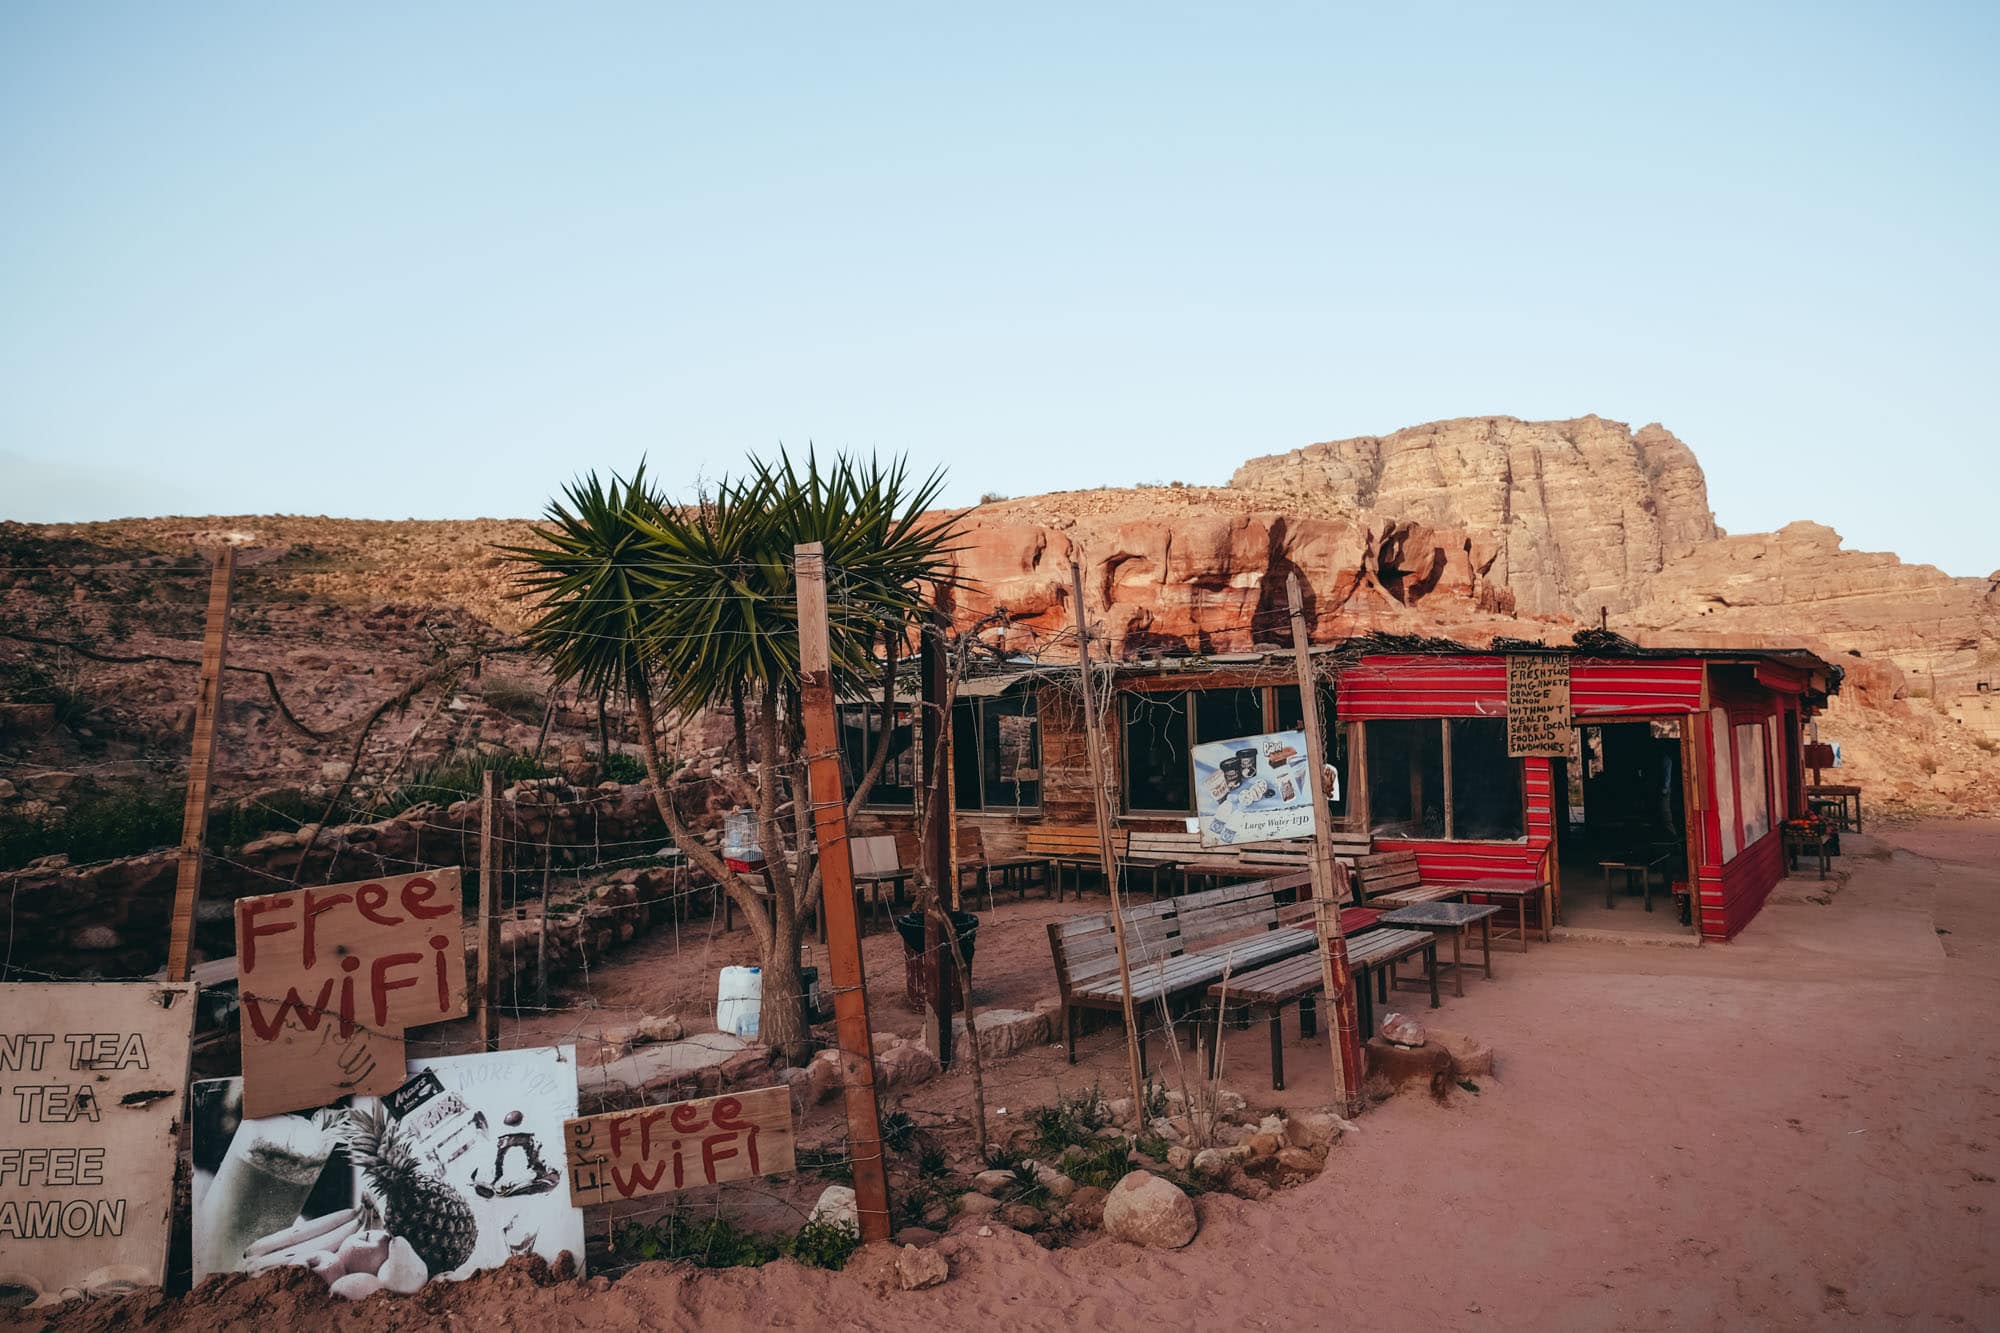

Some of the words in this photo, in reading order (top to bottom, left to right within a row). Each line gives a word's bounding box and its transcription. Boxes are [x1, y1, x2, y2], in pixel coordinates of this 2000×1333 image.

[1512, 656, 1537, 669] 100%
[1510, 690, 1551, 698] ORANGE
[1534, 731, 1555, 742] AND
[1543, 717, 1570, 730] LOCAL
[1267, 818, 1290, 829] Water
[242, 877, 455, 974] Free
[65, 1033, 149, 1070] TEA
[13, 1085, 101, 1123] TEA
[394, 1076, 427, 1108] Mars
[608, 1096, 752, 1162] Free
[0, 1199, 127, 1239] AMON
